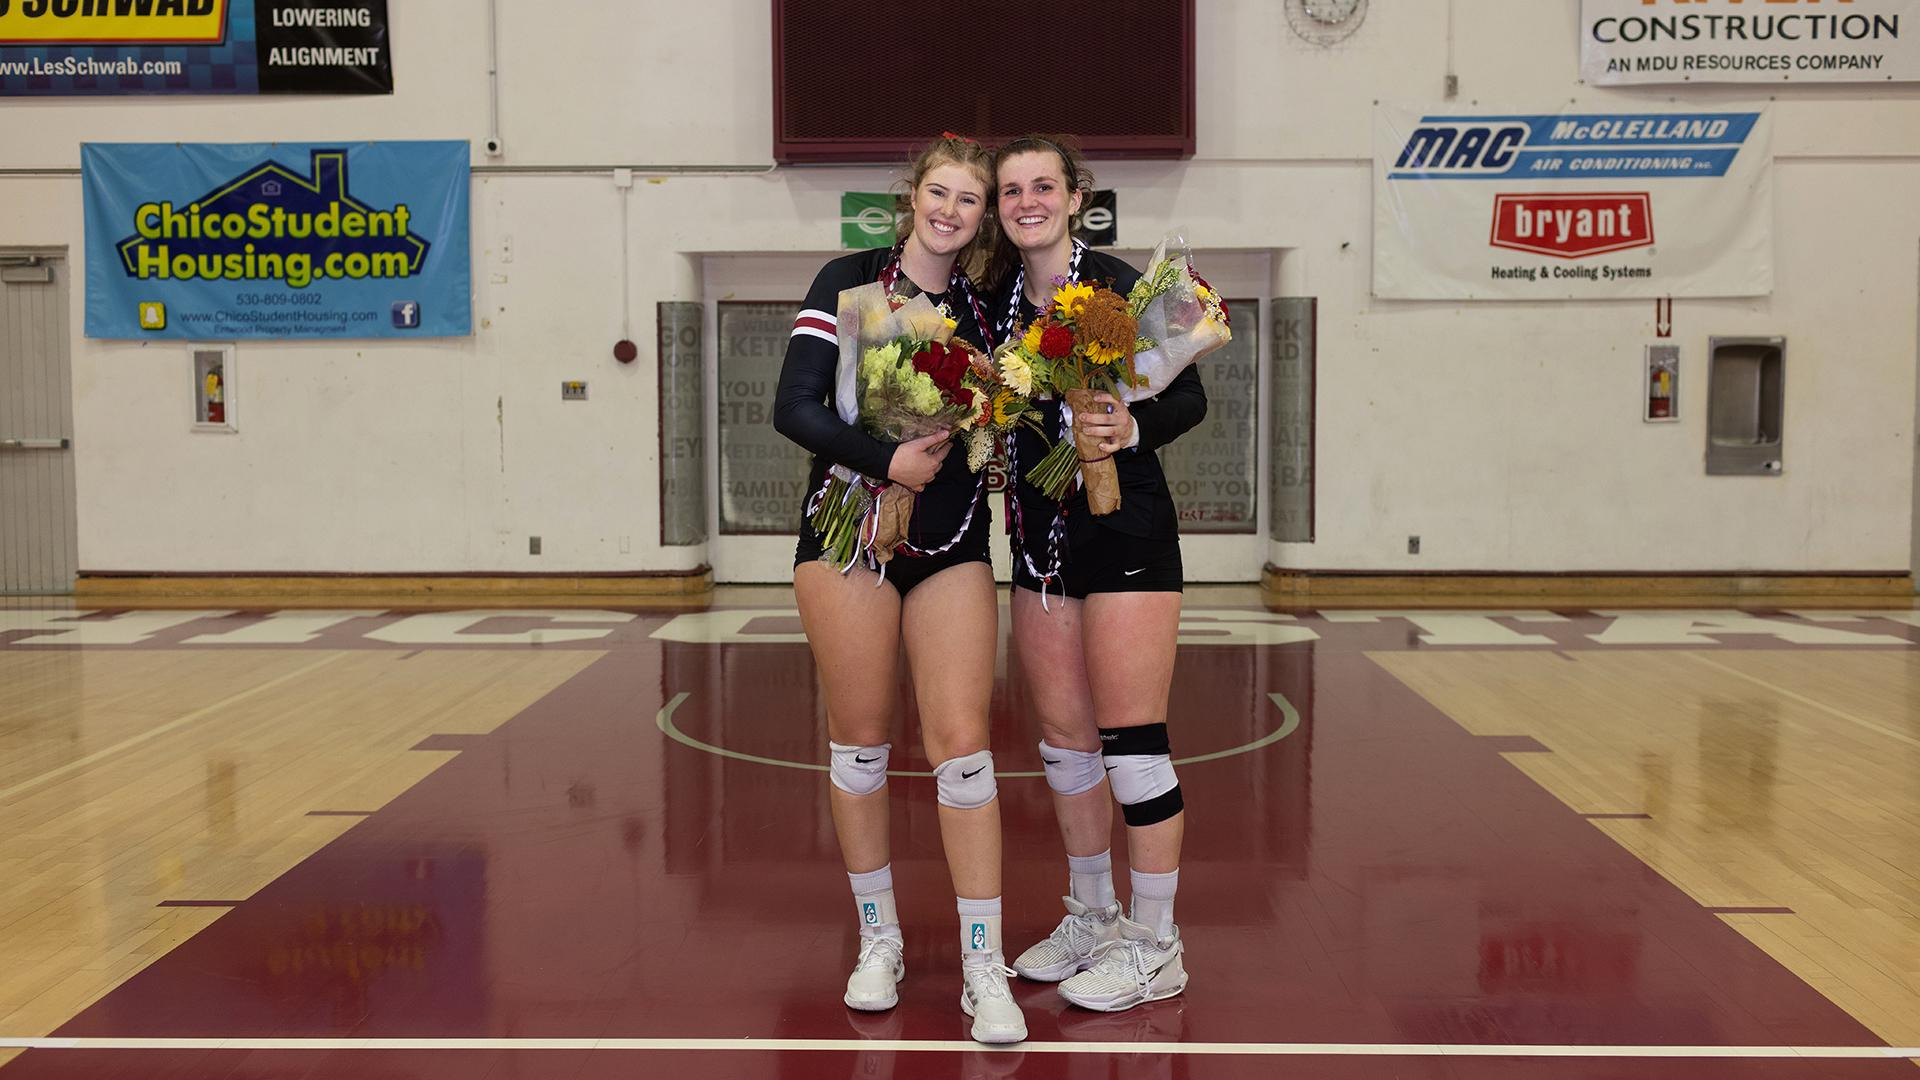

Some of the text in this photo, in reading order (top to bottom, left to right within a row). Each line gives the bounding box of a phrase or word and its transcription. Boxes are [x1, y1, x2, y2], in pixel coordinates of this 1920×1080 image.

[272, 8, 371, 28] LOWERING
[1592, 13, 1899, 44] CONSTRUCTION
[268, 47, 380, 67] ALIGNMENT
[1606, 54, 1884, 73] AN MDU RESOURCES COMPANY
[1550, 120, 1729, 140] McCLELLAND
[1394, 127, 1525, 168] MAC
[1530, 158, 1563, 171] AIR
[1569, 157, 1693, 171] CONDITIONING
[136, 202, 410, 239] ChicoStudent
[1514, 203, 1632, 243] bryant
[137, 243, 410, 287] Housing.com
[1491, 264, 1652, 281] Heating & Cooling Systems
[236, 293, 322, 306] 530-809-0802
[180, 310, 378, 325] www.ChicoStudentHousing.com
[255, 324, 291, 336] Property
